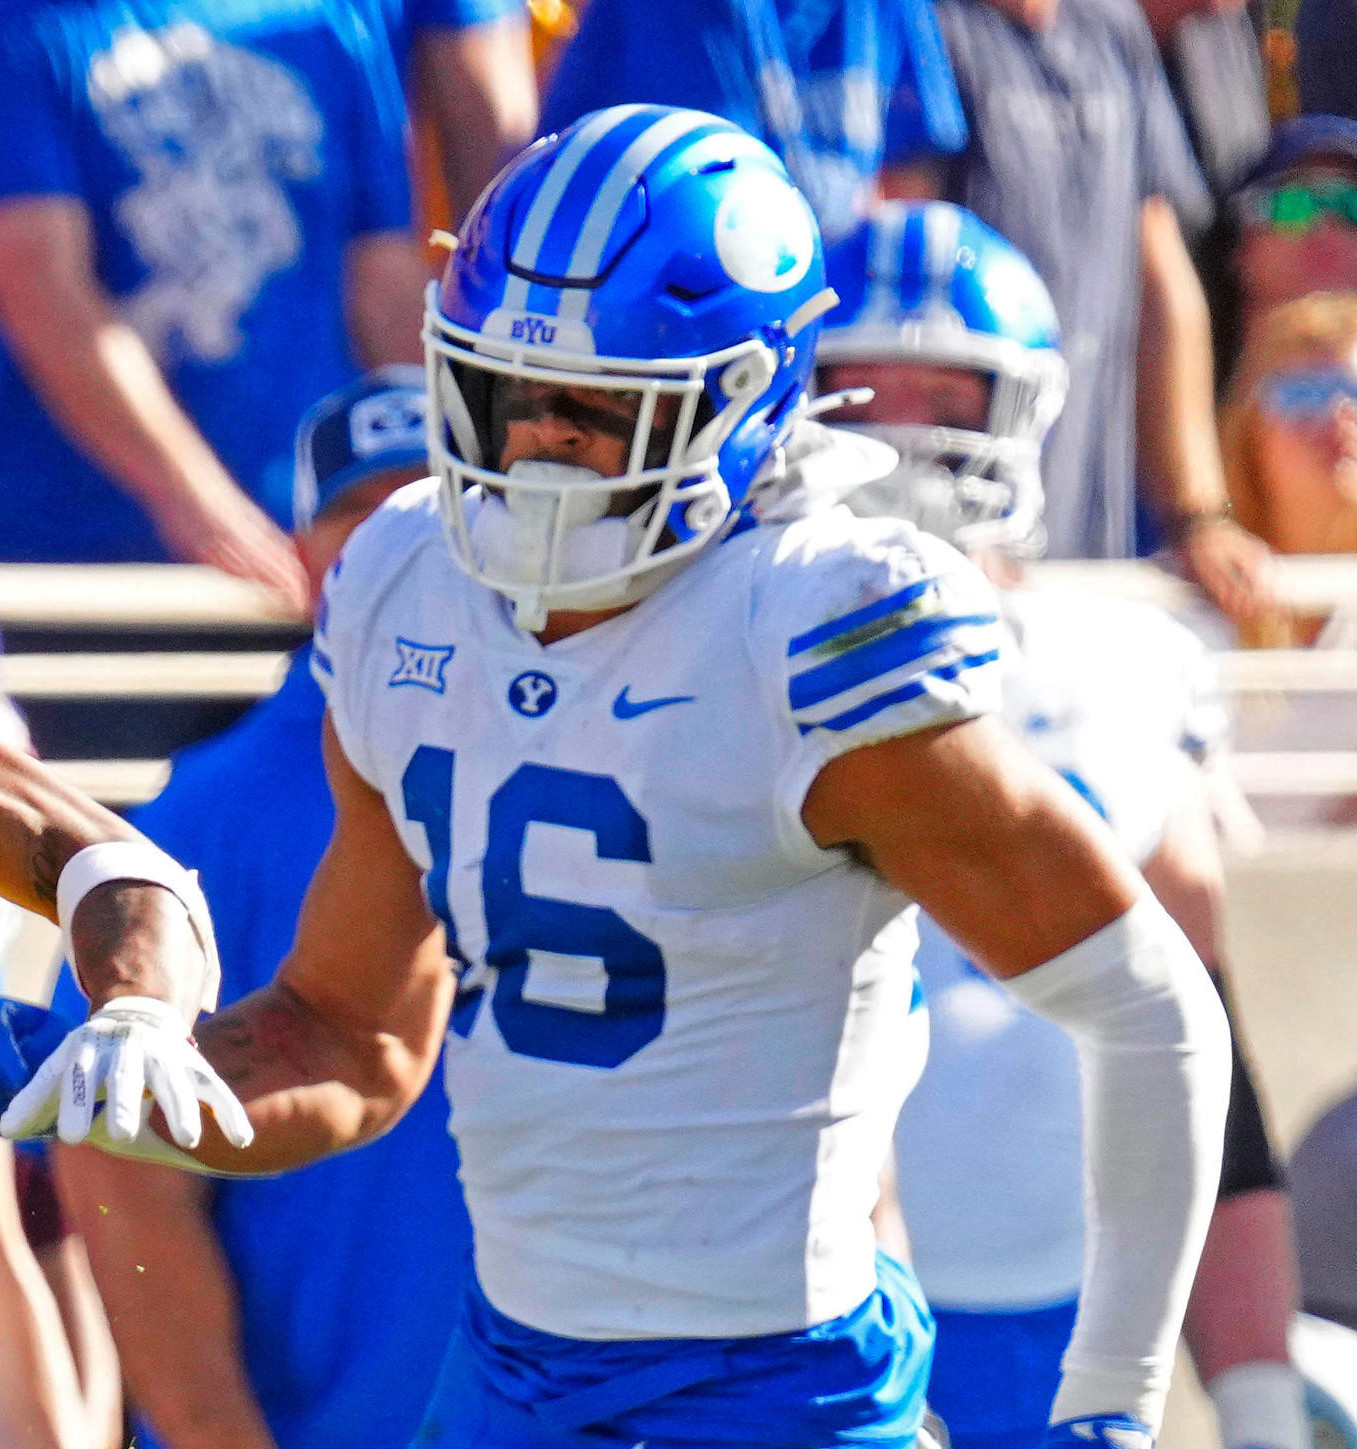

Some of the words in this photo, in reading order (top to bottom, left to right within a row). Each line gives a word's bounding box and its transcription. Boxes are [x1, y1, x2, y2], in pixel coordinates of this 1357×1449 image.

[511, 317, 557, 344] BYU
[389, 636, 455, 694] XII
[512, 672, 555, 716] Y
[401, 744, 667, 1070] 16
